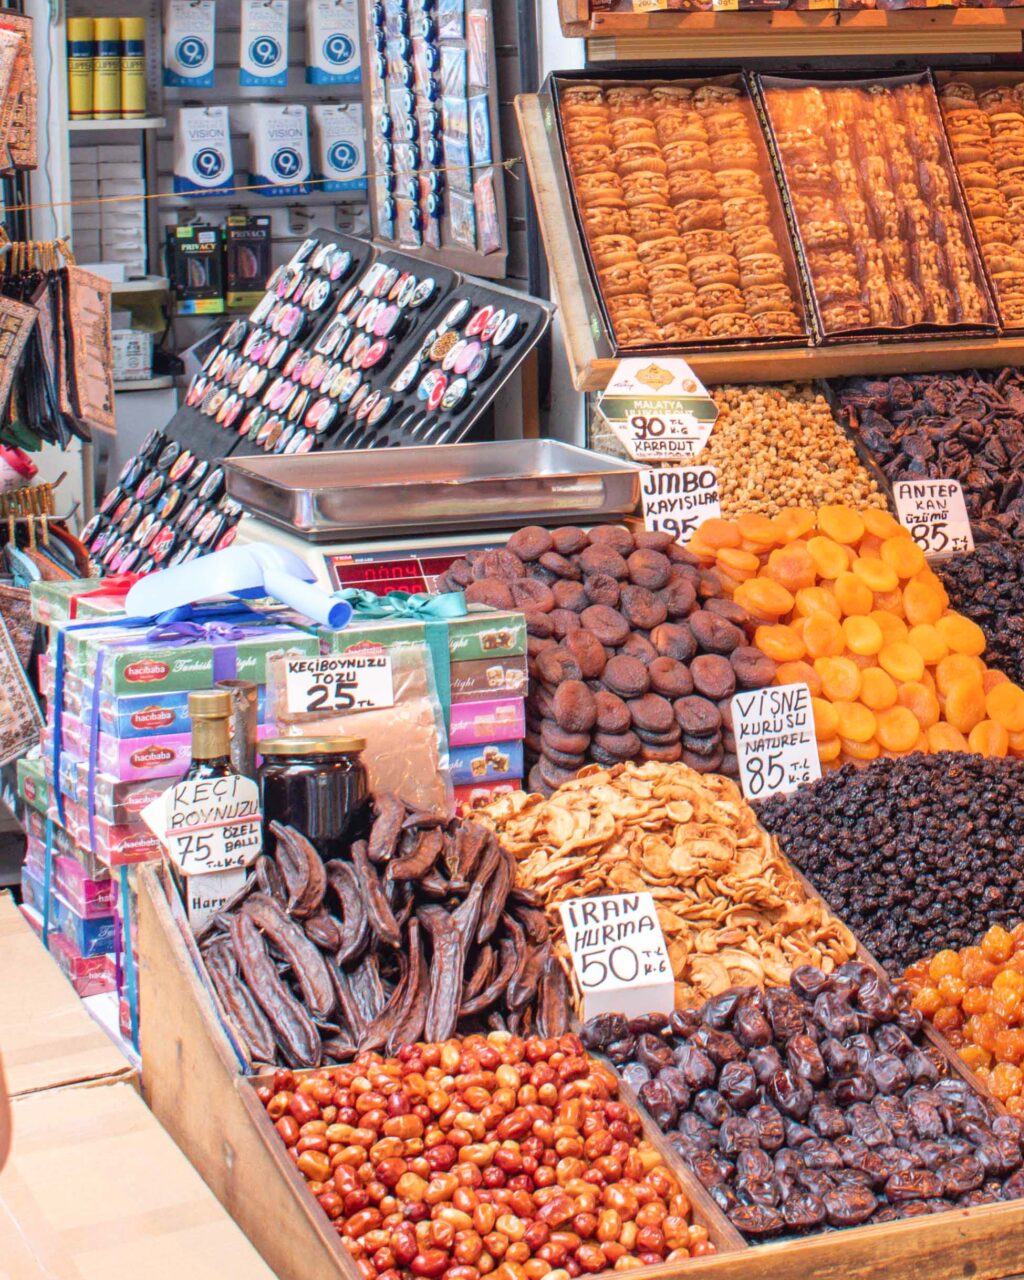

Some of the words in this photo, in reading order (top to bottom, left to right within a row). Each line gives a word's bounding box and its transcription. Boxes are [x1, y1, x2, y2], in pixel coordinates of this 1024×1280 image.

[188, 128, 224, 138] VISION
[268, 128, 303, 138] VISION
[231, 230, 267, 238] PRIVACY
[181, 243, 217, 251] PRIVACY
[634, 401, 684, 410] MALATYA
[631, 416, 666, 440] 90
[899, 484, 958, 499] ANTEP
[646, 491, 719, 517] KAYISILAR
[916, 499, 947, 510] KAN
[911, 522, 949, 552] 85
[288, 656, 387, 674] KEÇİBOYNUZU
[312, 671, 357, 685] TOZU
[306, 682, 360, 712] 25
[357, 699, 375, 707] TL
[736, 688, 808, 719] VİŞNE
[745, 732, 810, 755] NATUREL
[746, 752, 785, 795] 85
[174, 775, 241, 810] KEÇİ
[171, 800, 259, 829] BOYNUZU
[177, 833, 214, 866] 75
[222, 823, 258, 839] ÖZEL
[225, 836, 258, 853] BALLI
[568, 895, 640, 928] İRAN
[574, 915, 655, 952] HURMA
[581, 945, 639, 988] 50
